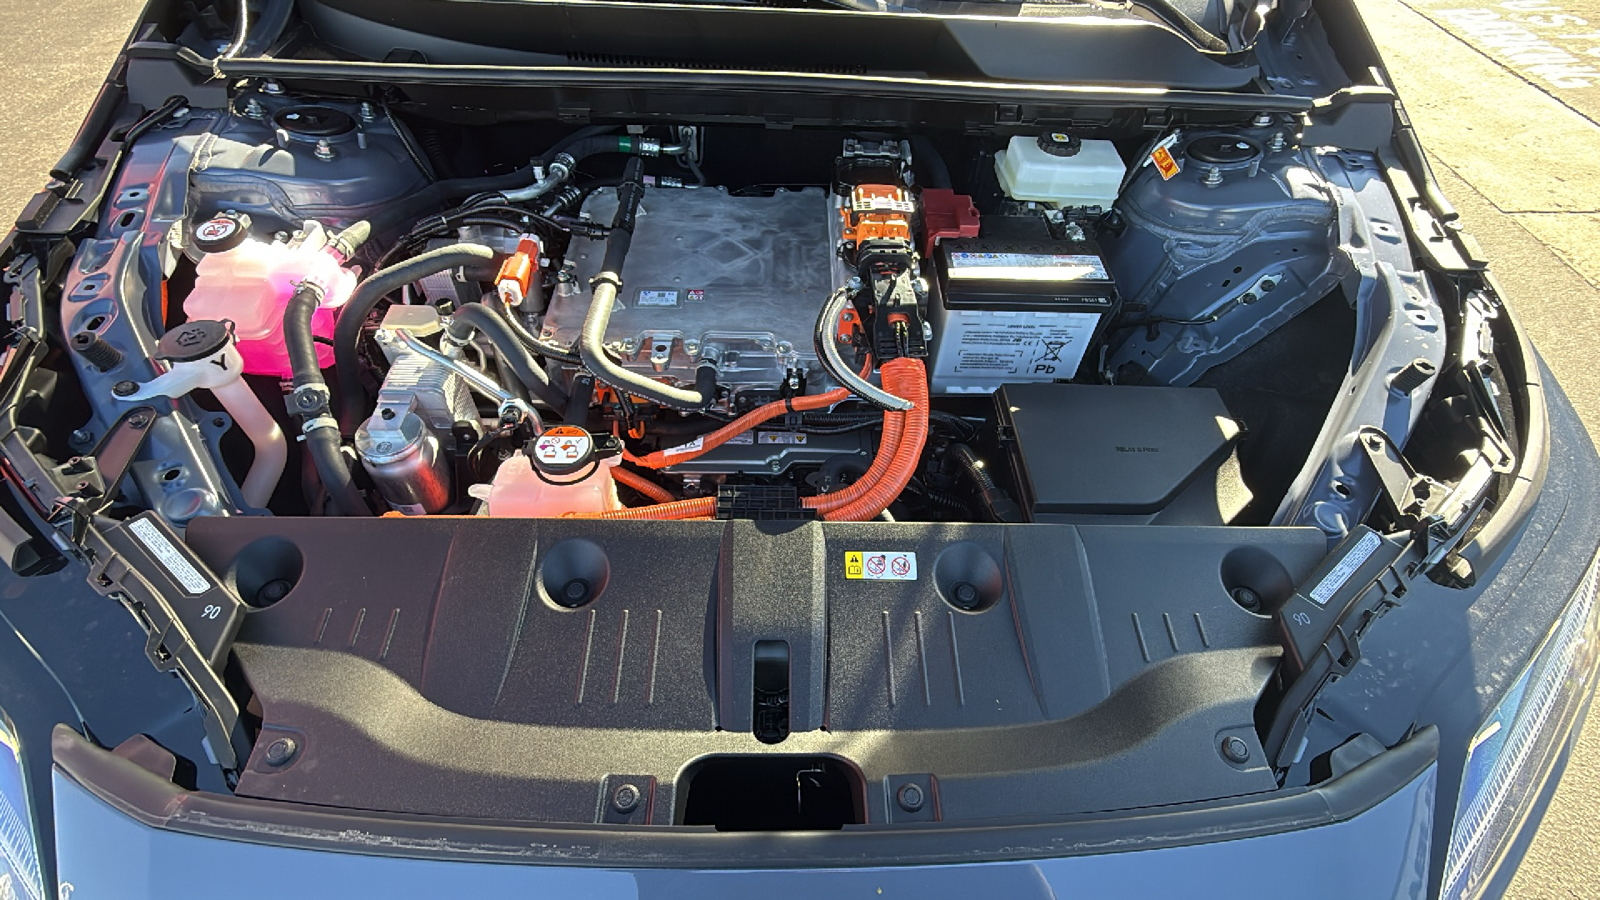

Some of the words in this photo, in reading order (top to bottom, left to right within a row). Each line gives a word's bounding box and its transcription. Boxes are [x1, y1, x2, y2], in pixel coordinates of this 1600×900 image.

[1433, 8, 1600, 88] PARKING
[1034, 364, 1055, 374] Pb
[201, 604, 221, 619] 90
[1293, 612, 1311, 626] 90
